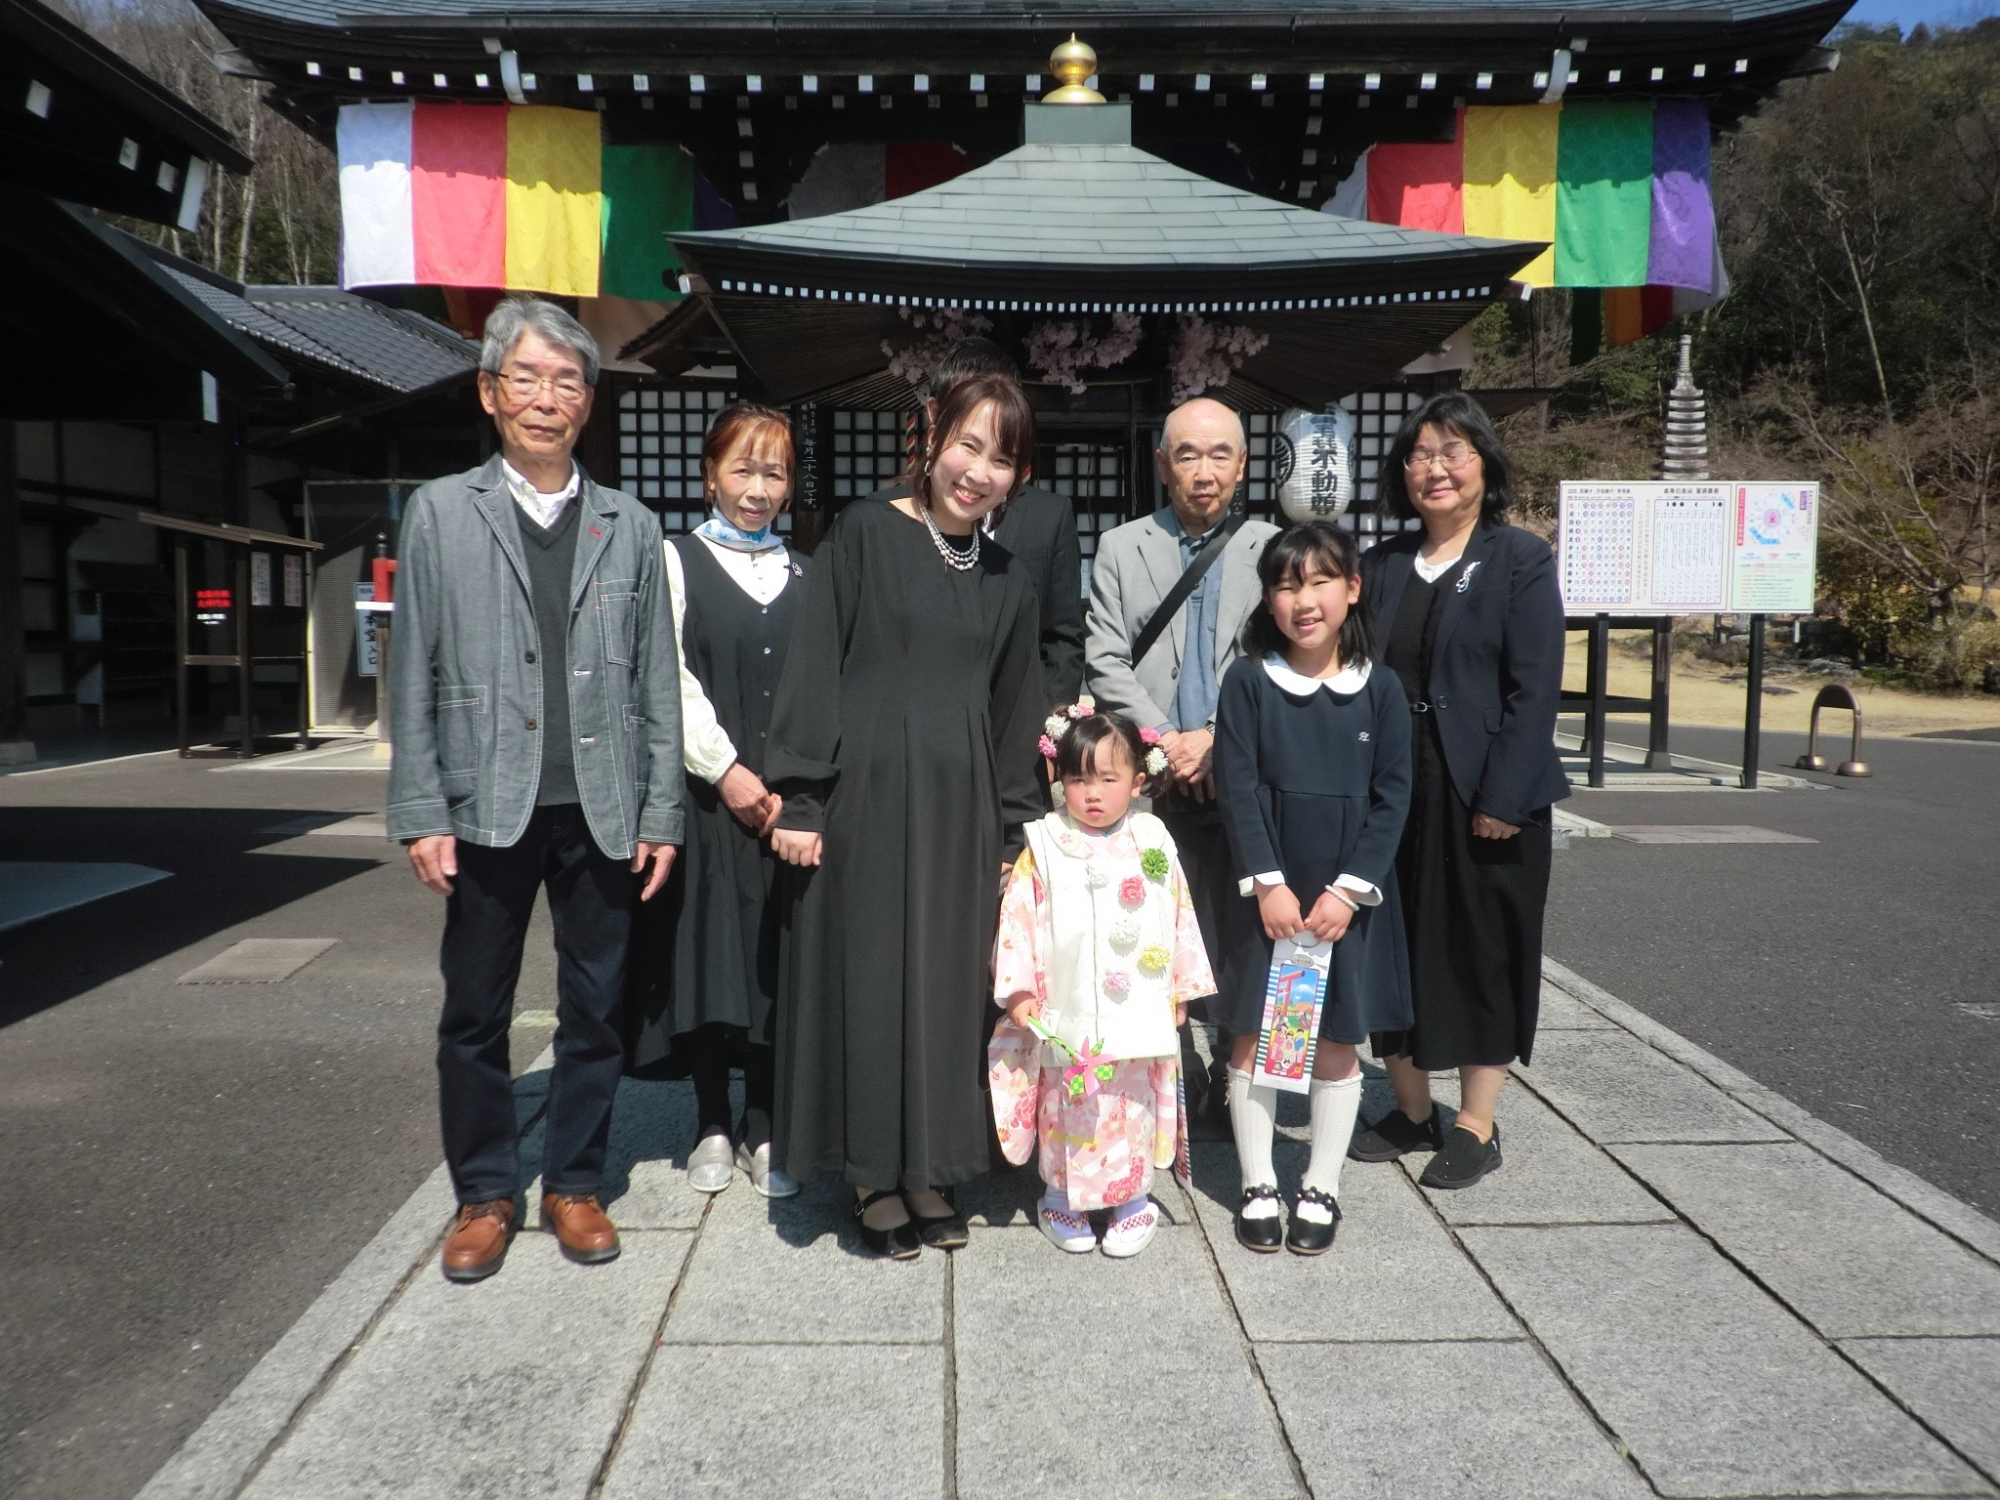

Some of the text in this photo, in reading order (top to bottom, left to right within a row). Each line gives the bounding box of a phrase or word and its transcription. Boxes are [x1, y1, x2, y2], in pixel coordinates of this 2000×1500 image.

[802, 438, 818, 509] 毎月二十八日です。
